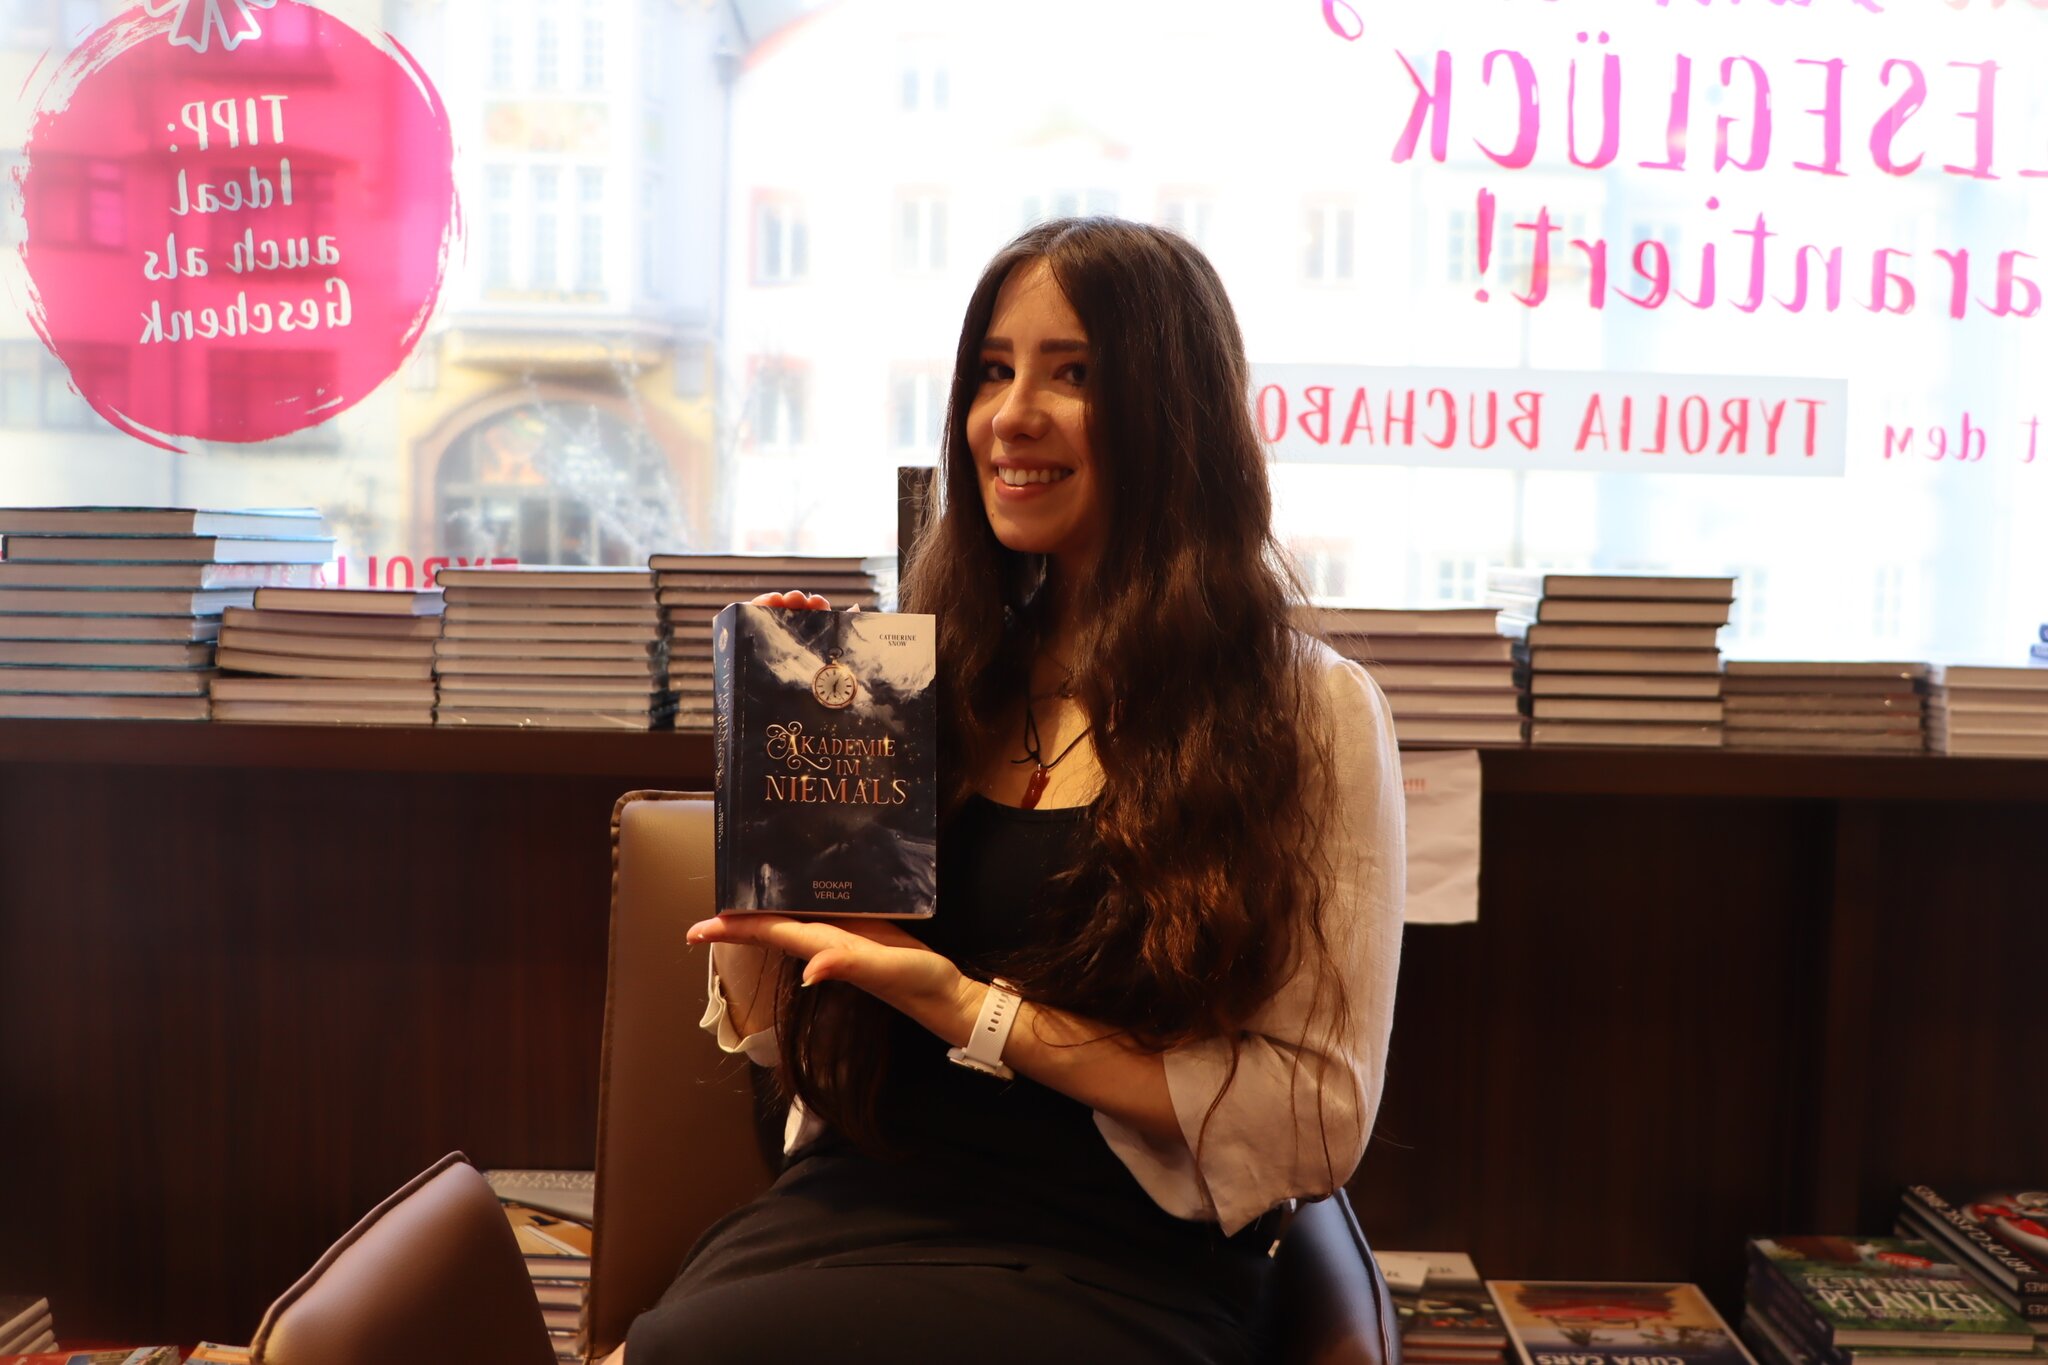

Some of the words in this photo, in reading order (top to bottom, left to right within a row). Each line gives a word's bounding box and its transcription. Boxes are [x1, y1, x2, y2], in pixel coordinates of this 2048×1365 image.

[766, 721, 895, 770] AKADEMIE
[836, 759, 861, 776] IM
[765, 775, 907, 805] NIEMALS
[812, 880, 853, 889] BOOKAPI
[815, 891, 850, 900] VERLAG
[1817, 1290, 1997, 1313] PFLANZEN
